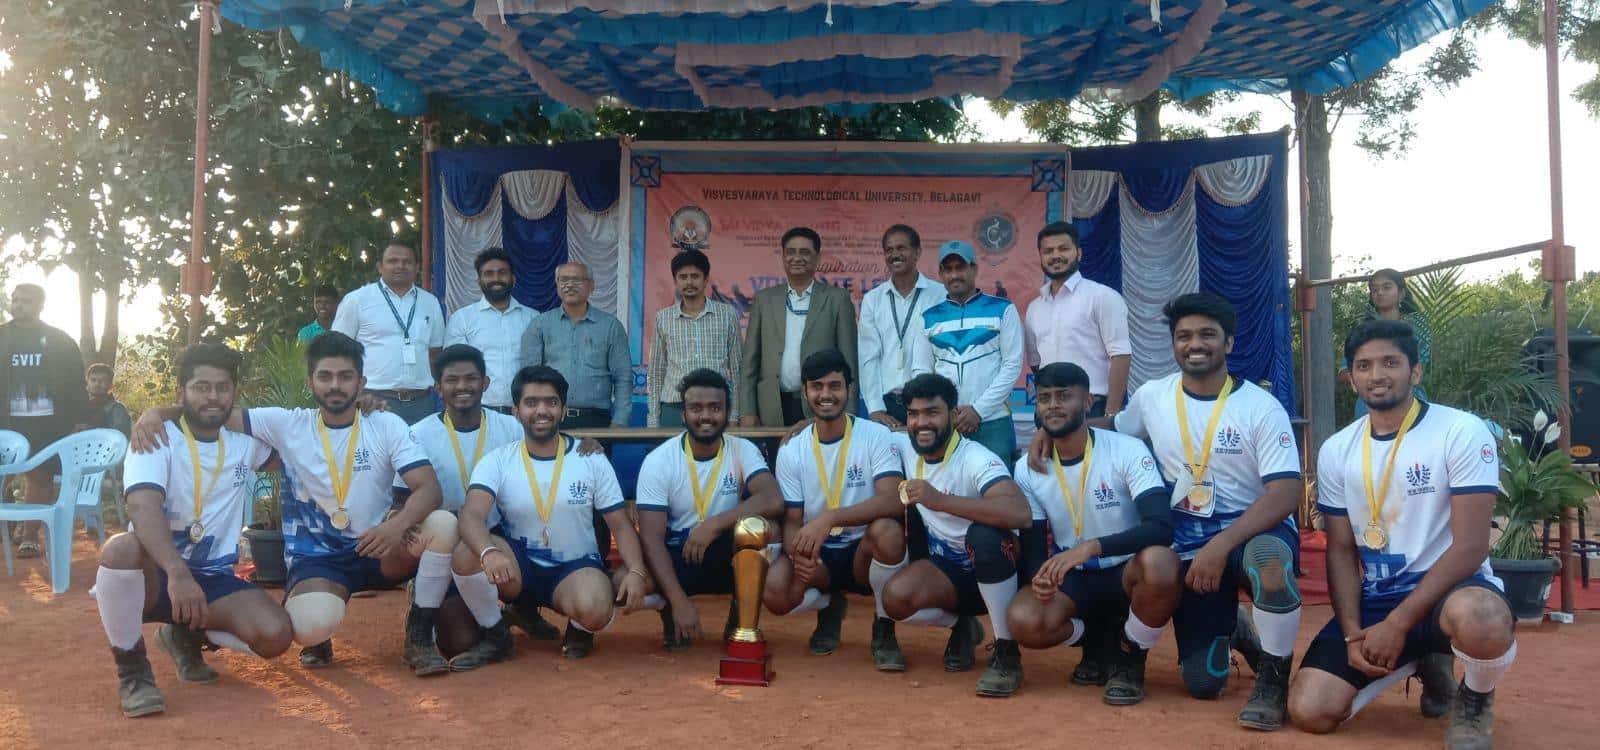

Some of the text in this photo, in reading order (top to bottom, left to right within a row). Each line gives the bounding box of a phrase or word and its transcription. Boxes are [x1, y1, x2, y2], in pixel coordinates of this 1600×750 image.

[784, 189, 861, 203] TECHNOLOGICAL
[931, 191, 983, 205] BELAGAVI
[11, 353, 43, 366] SVIT
